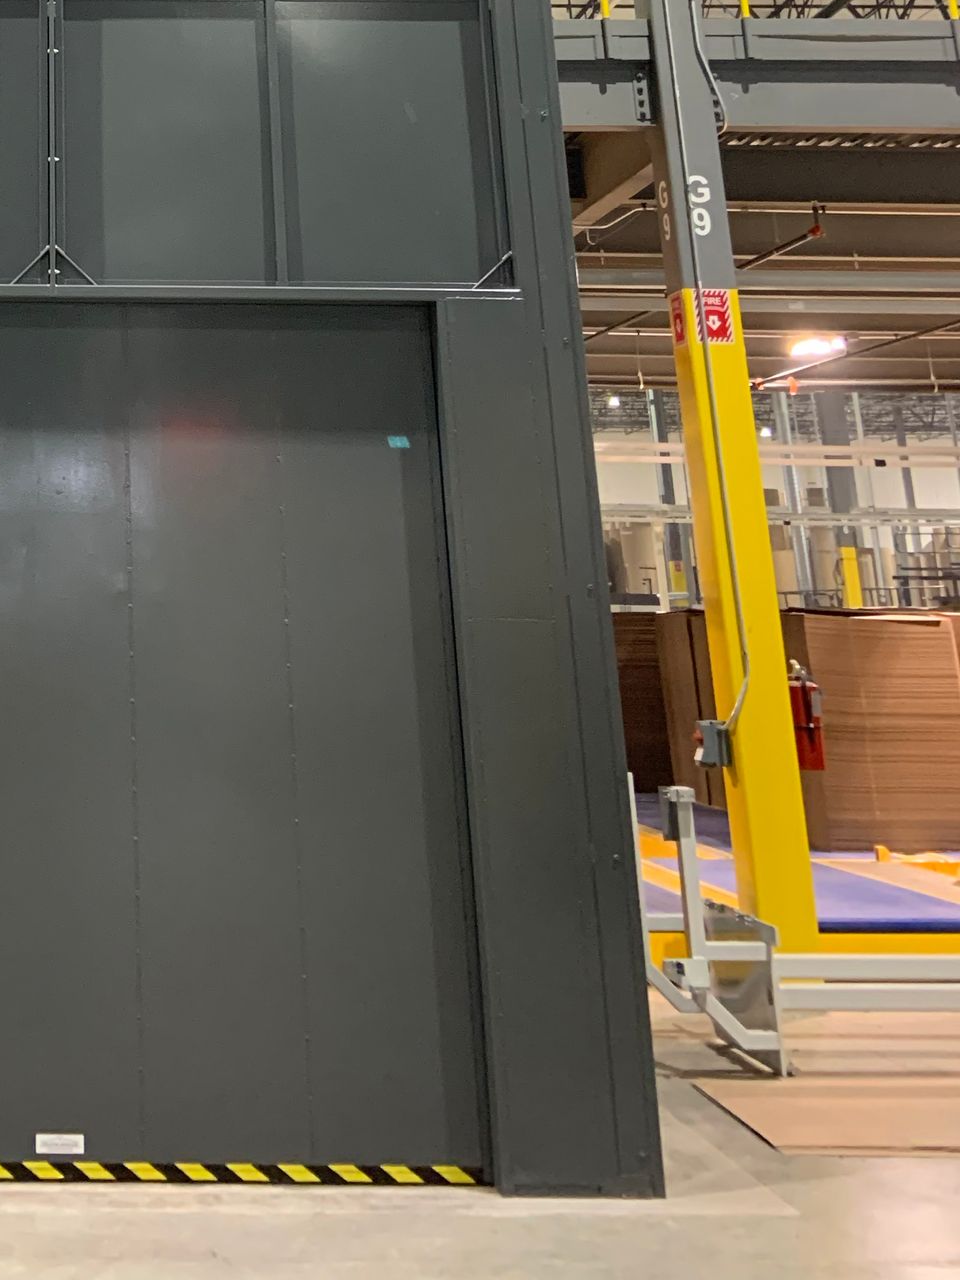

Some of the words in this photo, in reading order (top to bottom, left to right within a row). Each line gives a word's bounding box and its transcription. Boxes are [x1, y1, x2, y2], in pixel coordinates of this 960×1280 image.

[658, 180, 669, 209] G
[688, 175, 711, 204] G
[663, 213, 671, 240] 9
[692, 207, 711, 236] 9
[703, 297, 722, 306] FIRE
